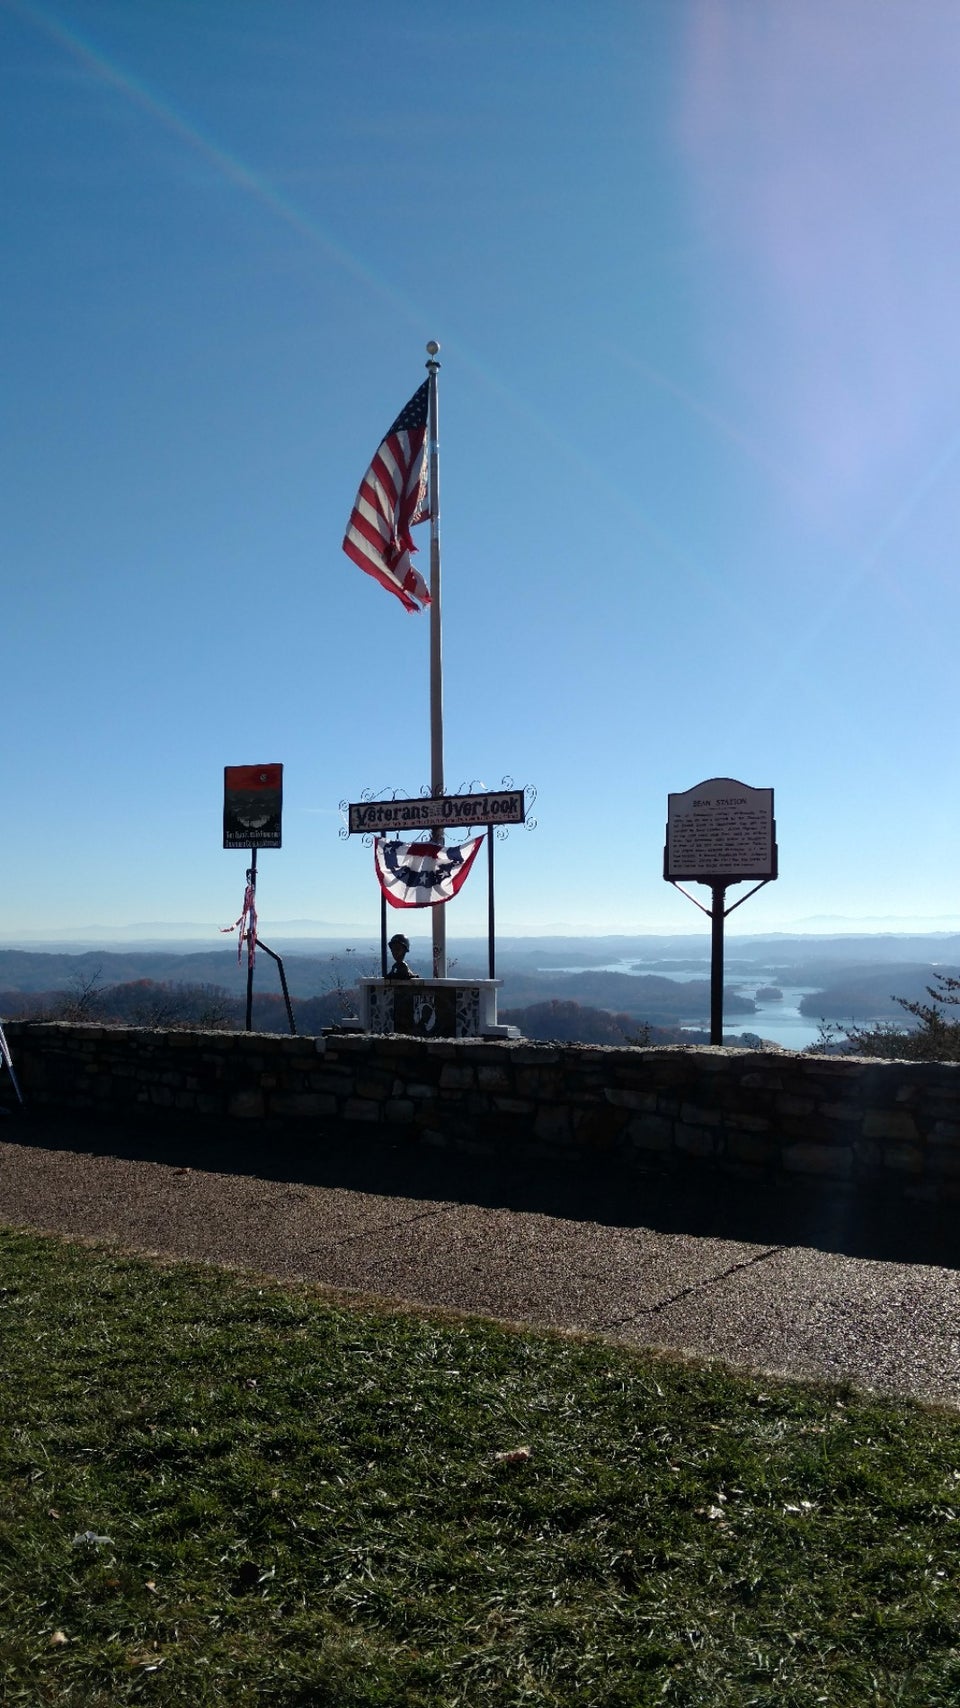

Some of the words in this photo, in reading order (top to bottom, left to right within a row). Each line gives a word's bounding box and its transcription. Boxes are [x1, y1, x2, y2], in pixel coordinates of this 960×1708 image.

[356, 804, 430, 827] Veterans
[441, 796, 518, 818] Overlook
[716, 798, 747, 806] STATION
